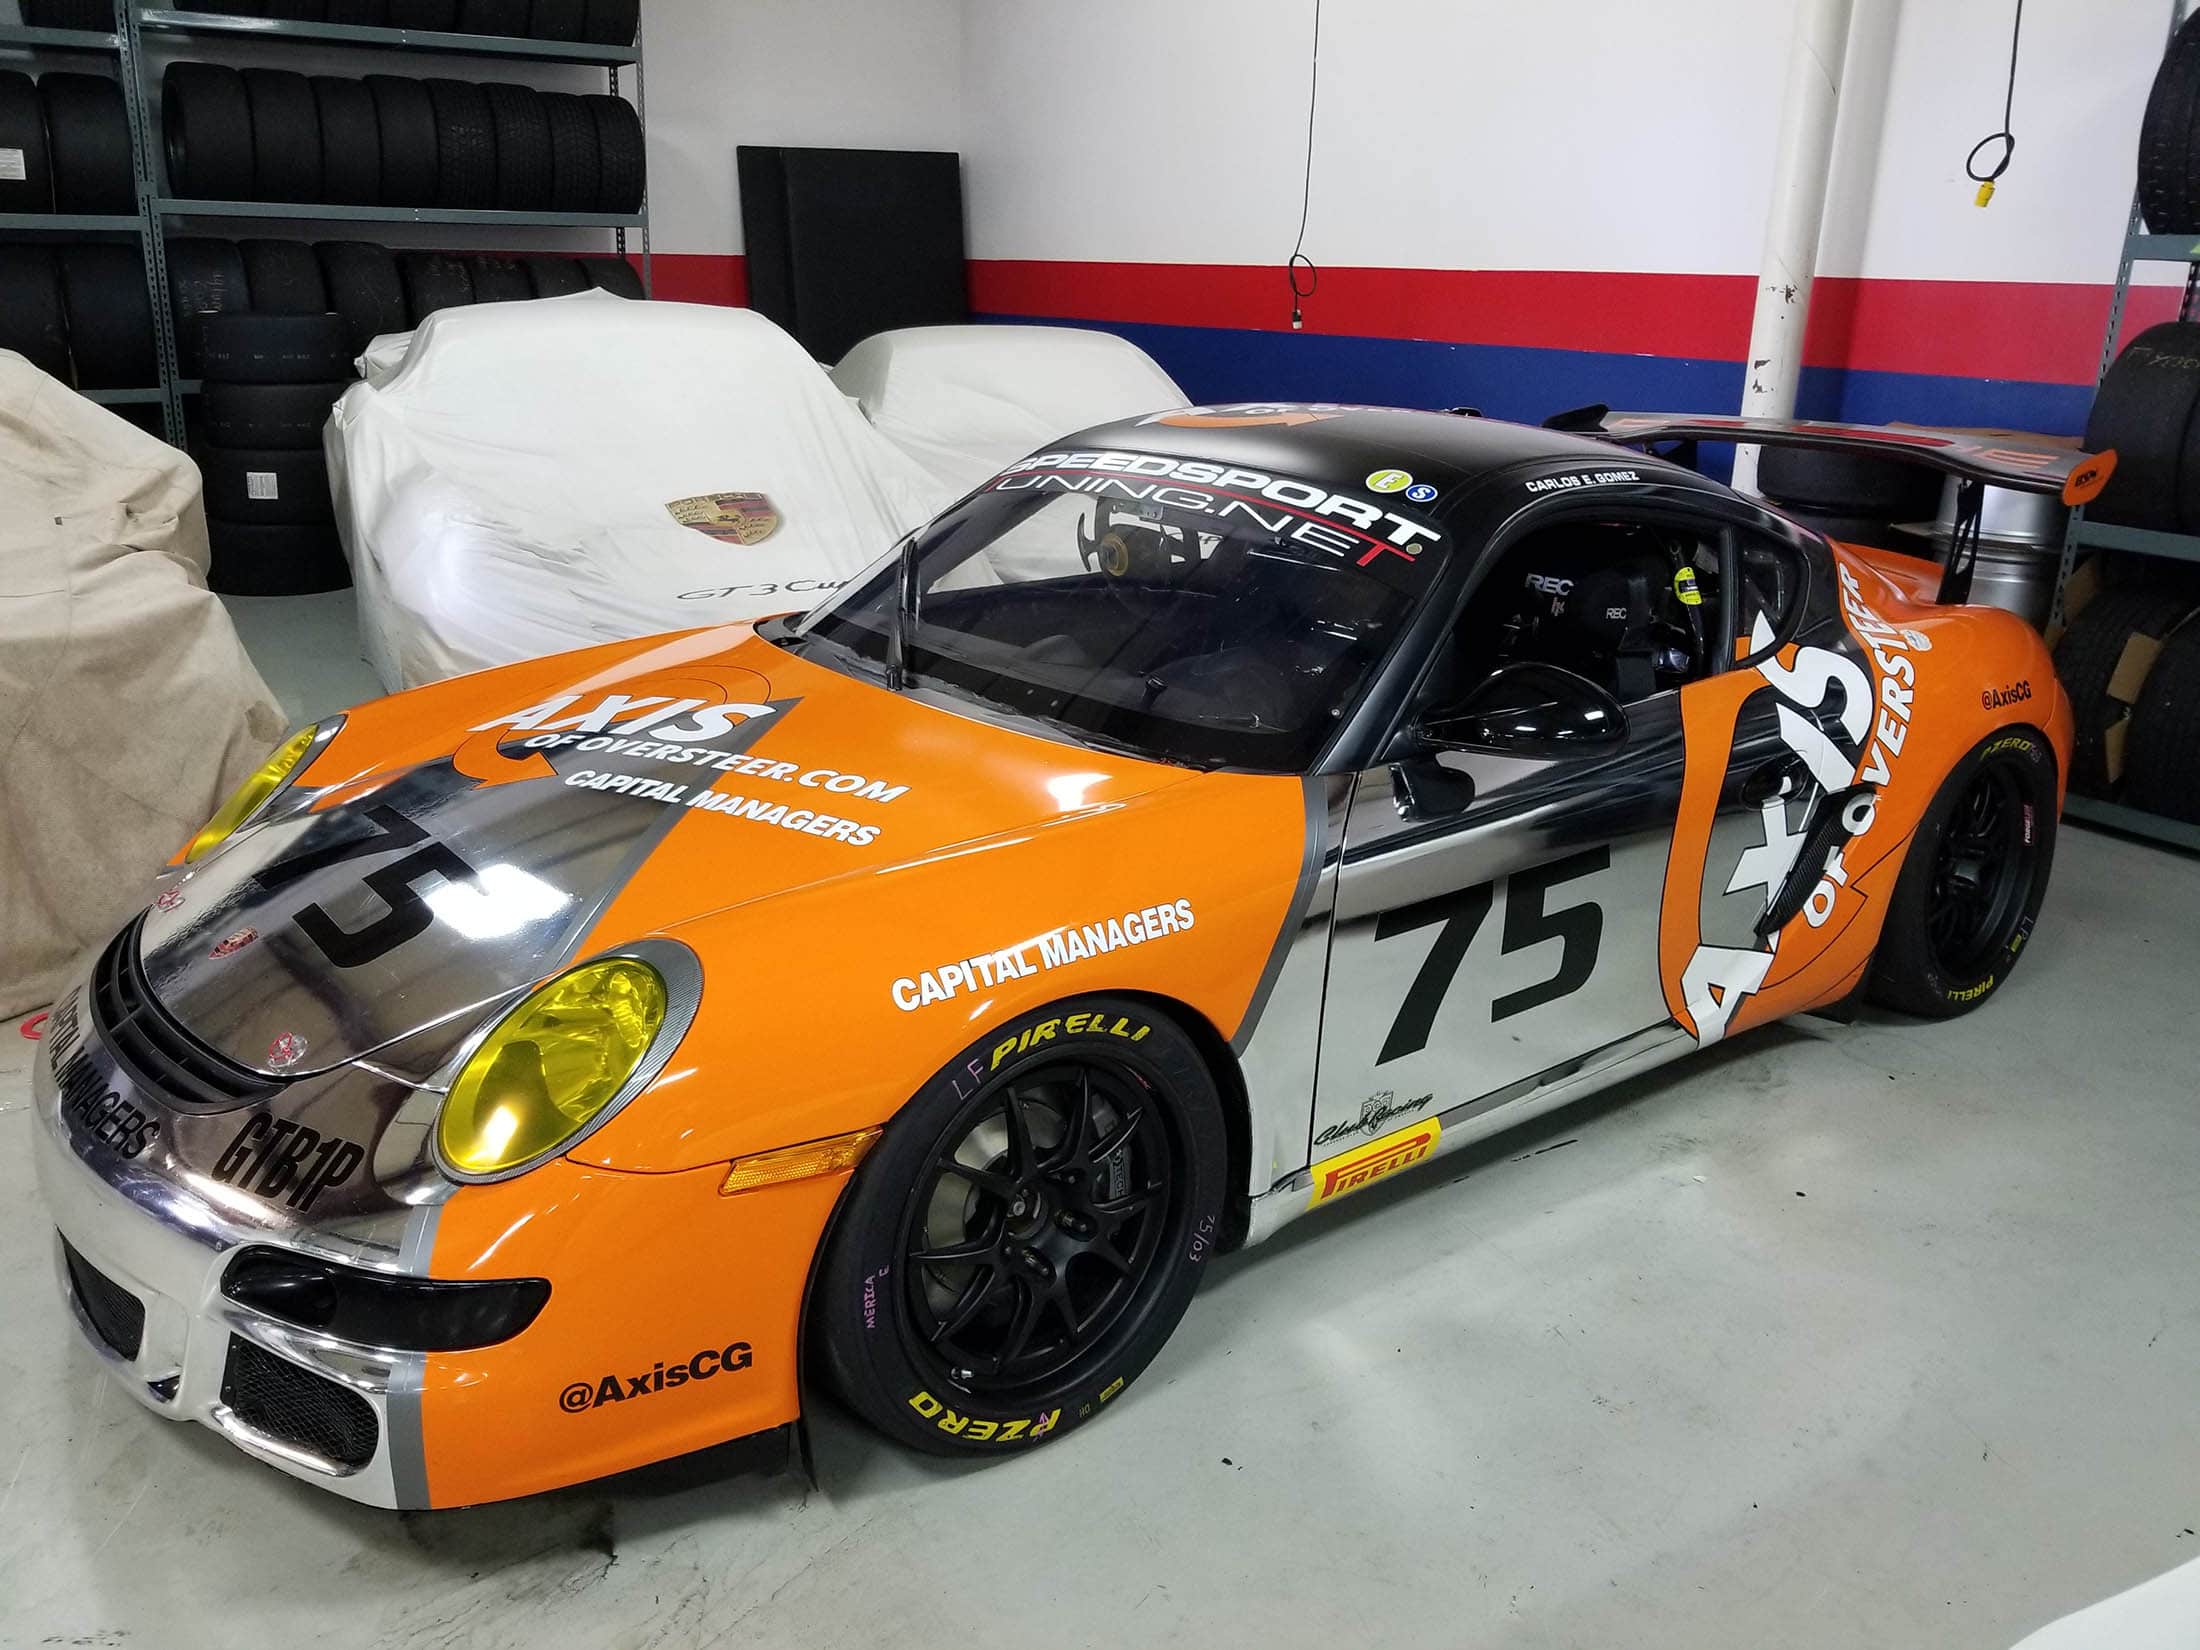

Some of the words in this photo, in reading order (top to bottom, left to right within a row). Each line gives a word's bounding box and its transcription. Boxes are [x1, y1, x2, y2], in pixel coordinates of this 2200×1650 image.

[1001, 452, 1441, 546] SPEEDSPORT
[1525, 476, 1581, 492] CARLOS
[1581, 475, 1596, 485] E.
[1594, 471, 1640, 483] GOMEZ
[677, 583, 778, 600] GT3
[1525, 573, 1575, 596] REC
[1606, 607, 1627, 619] REC
[466, 694, 777, 742] AXIS
[1982, 680, 2032, 710] @AxisCG
[1803, 845, 1848, 929] OF
[1838, 562, 1915, 837] OVERSTEER
[564, 770, 692, 805] CAPITAL
[688, 790, 882, 847] MANAGERS
[252, 803, 490, 968] 75
[891, 950, 1037, 1012] CAPITAL
[1036, 898, 1195, 970] MANAGERS
[1374, 844, 1610, 1068] 75
[1947, 974, 1994, 1002] PIRELLI
[989, 1012, 1151, 1072] PIRELLI
[54, 1045, 161, 1160] MANAGERS
[952, 1058, 984, 1100] LF
[211, 1111, 365, 1214] GTB1P
[1320, 1132, 1431, 1200] PIRELLI
[1189, 1215, 1216, 1262] 75/03
[559, 1341, 753, 1414] @AxisCG
